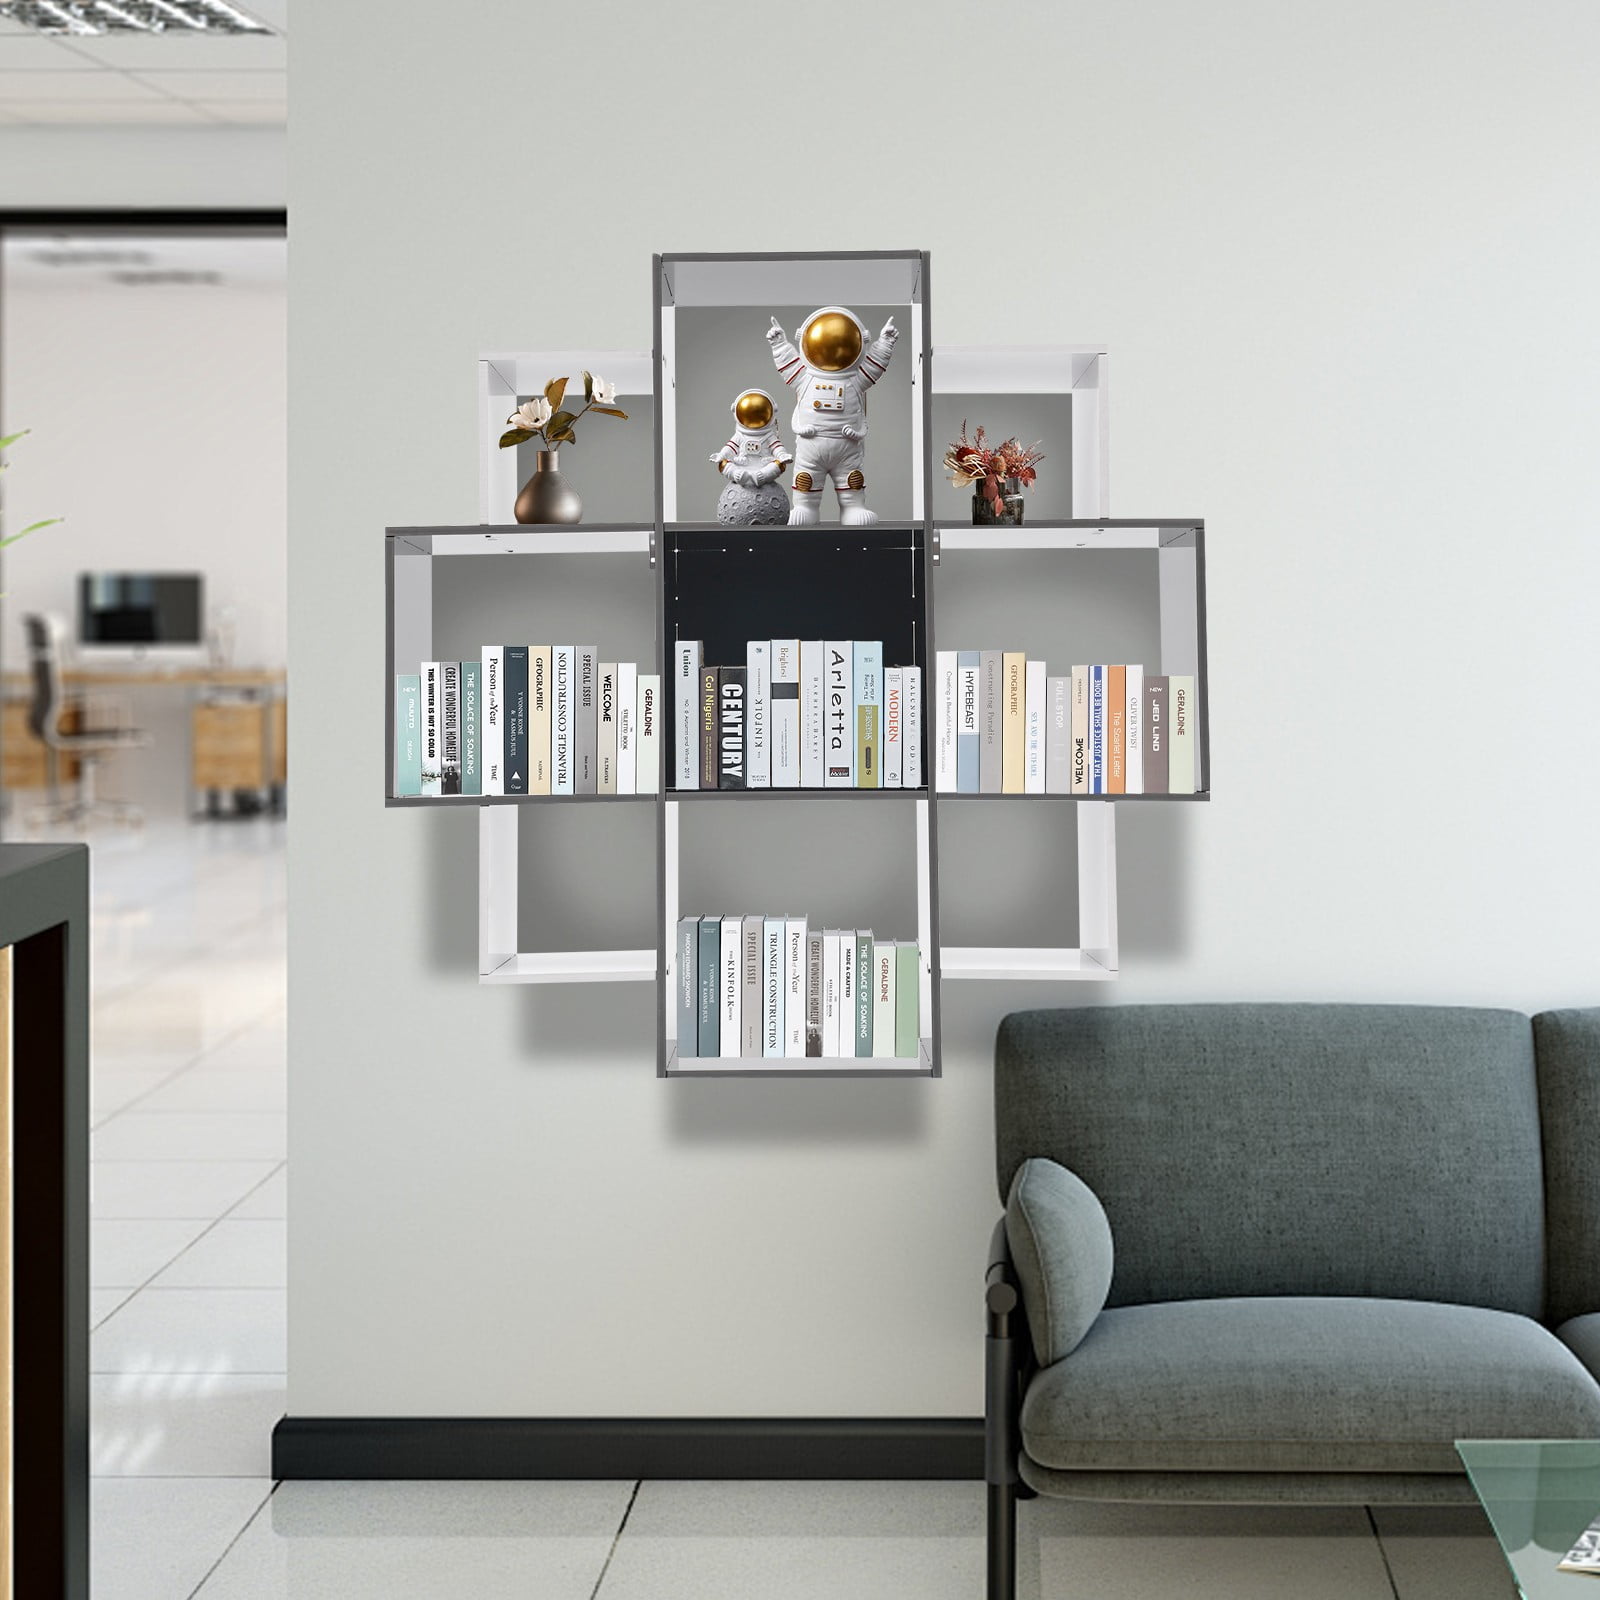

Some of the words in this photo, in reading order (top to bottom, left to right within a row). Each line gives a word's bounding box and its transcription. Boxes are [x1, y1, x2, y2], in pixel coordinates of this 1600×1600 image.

[445, 667, 456, 690] CREATE
[490, 658, 498, 690] Person
[582, 654, 592, 684] SPECIAL
[682, 649, 691, 677] Union
[558, 652, 567, 732] CONSTRUCTION
[582, 686, 592, 707] ISSUE
[602, 674, 612, 722] WELCOME
[705, 675, 714, 692] Col
[445, 690, 457, 730] WONDERFUL
[490, 704, 498, 726] Year
[644, 688, 653, 736] GERALDINE
[704, 694, 714, 730] Nigeria
[831, 650, 846, 750] Arletta
[888, 690, 899, 742] MODERN
[965, 671, 974, 730] HYPEBEAST
[1094, 698, 1102, 706] BE
[1177, 688, 1186, 736] GERALDINE
[428, 728, 436, 737] SO
[467, 724, 474, 736] OF
[722, 684, 743, 778] CENTURY
[754, 698, 763, 748] KINFOLK
[1114, 712, 1122, 726] The
[446, 730, 457, 762] HOMELIFE
[558, 734, 567, 786] TRIANGLE
[1075, 738, 1084, 784] WELCOME
[748, 932, 756, 962] SPECIAL
[770, 932, 778, 978] TRIANGLE
[792, 932, 800, 962] Person
[811, 940, 820, 960] CREATE
[792, 974, 800, 994] Year
[880, 958, 889, 1002] GERALDINE
[769, 978, 777, 1048] CONSTRUCTION
[860, 992, 868, 1002] OF
